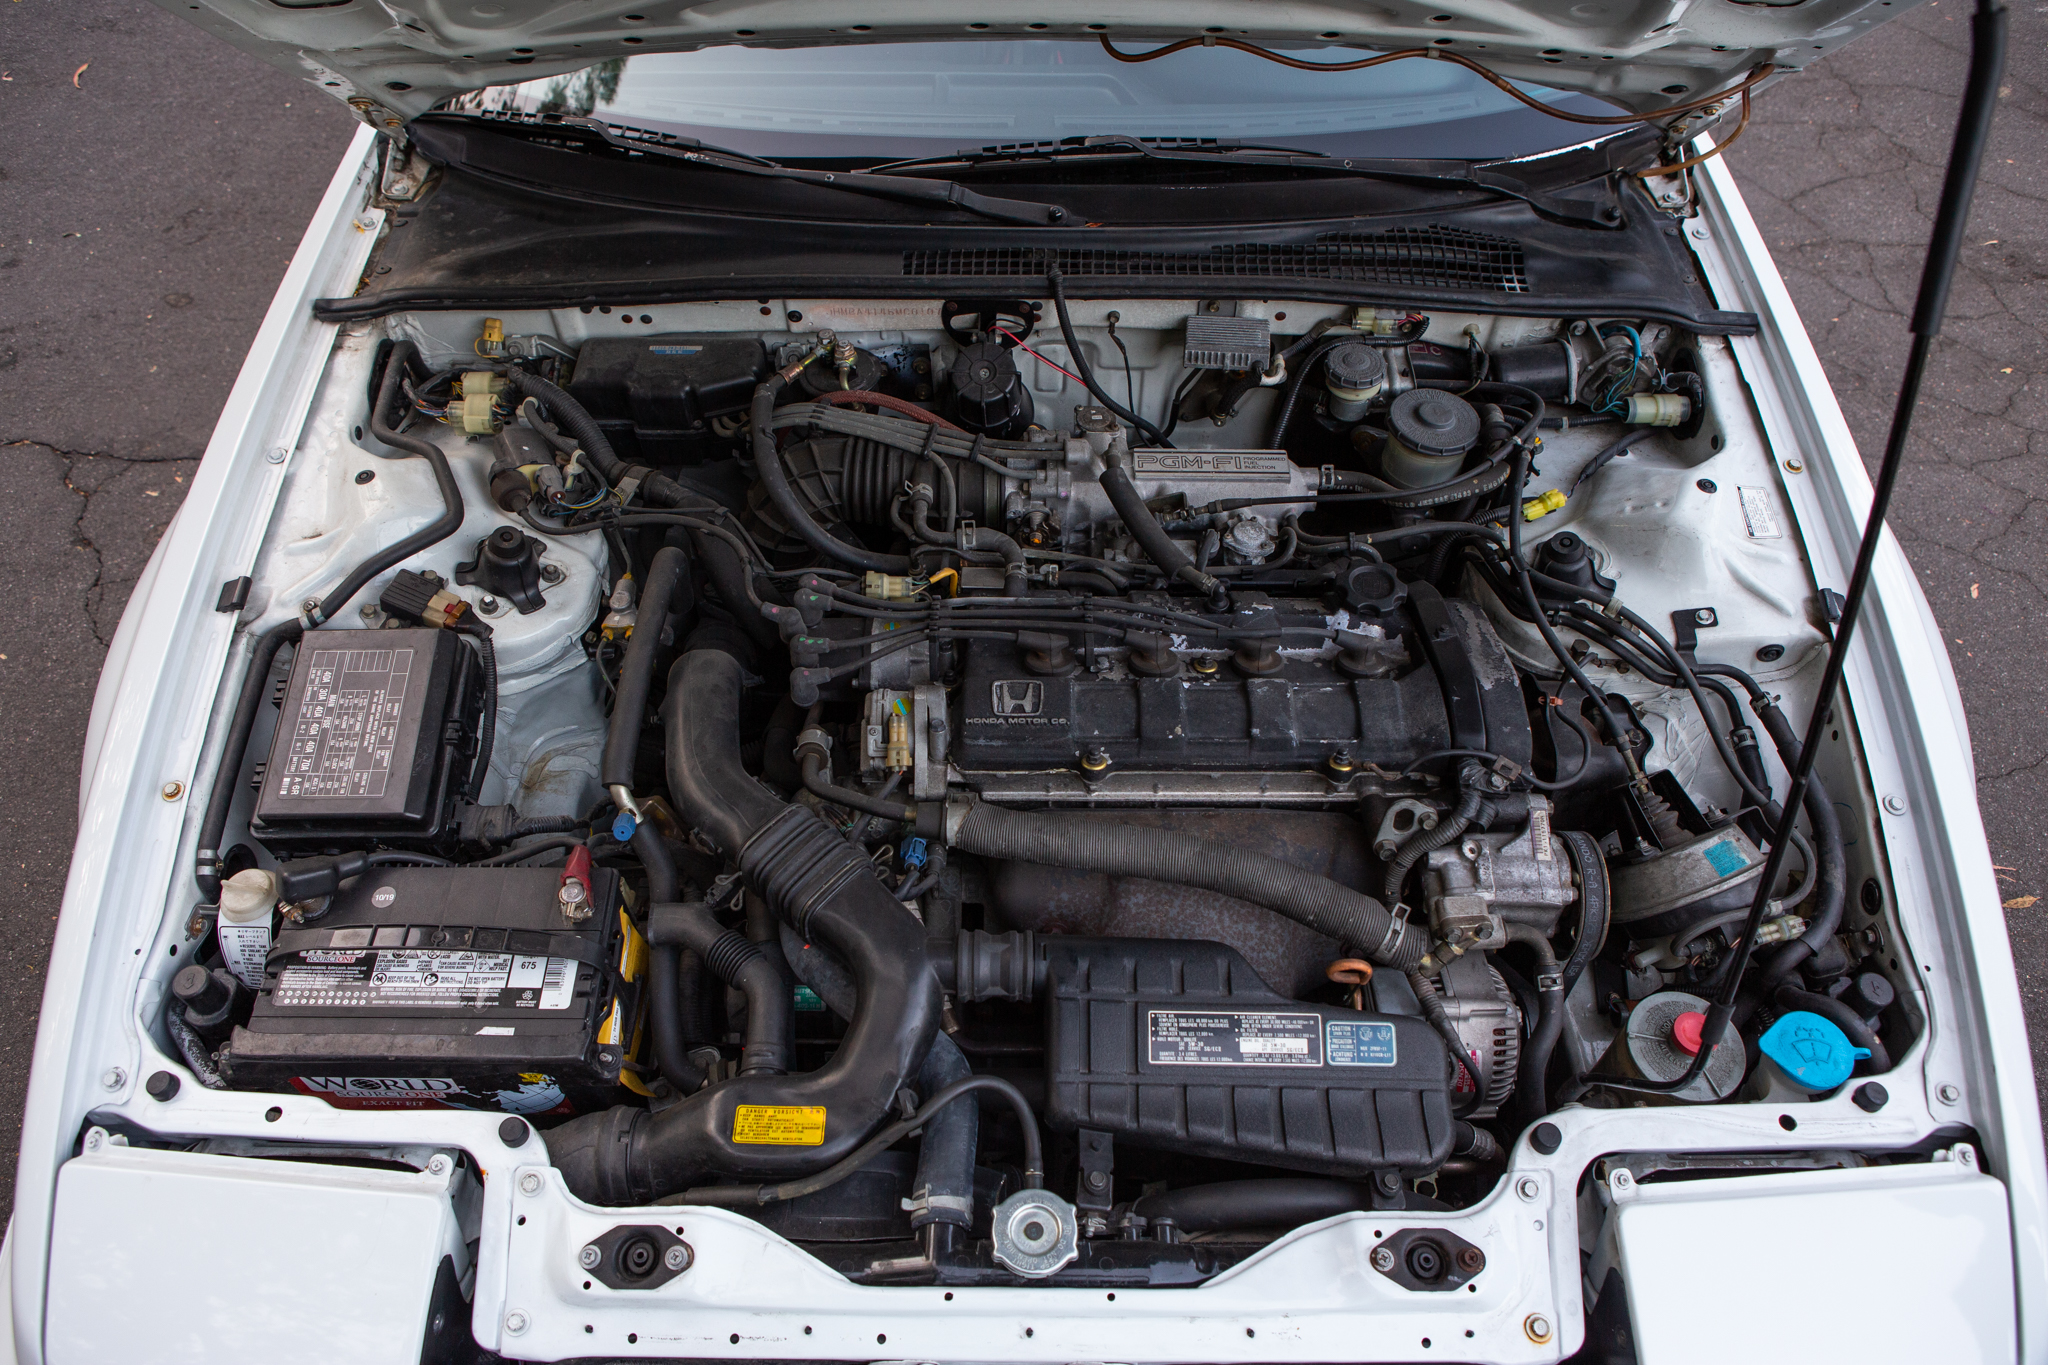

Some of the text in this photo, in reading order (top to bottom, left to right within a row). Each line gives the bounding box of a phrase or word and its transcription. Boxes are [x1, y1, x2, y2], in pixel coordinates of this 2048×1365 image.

[1138, 456, 1242, 469] PGM-FI
[321, 671, 332, 682] 40A
[317, 688, 328, 700] 30A
[313, 705, 324, 717] 40A
[321, 694, 337, 728] MAIN FUSE
[374, 704, 382, 719] REPLACE
[308, 723, 320, 734] 40A
[304, 740, 315, 752] 40A
[288, 756, 298, 772] BATTERY
[299, 758, 311, 770] 70A
[330, 757, 338, 769] CLOCK
[337, 1090, 445, 1098] SOURCEONE
